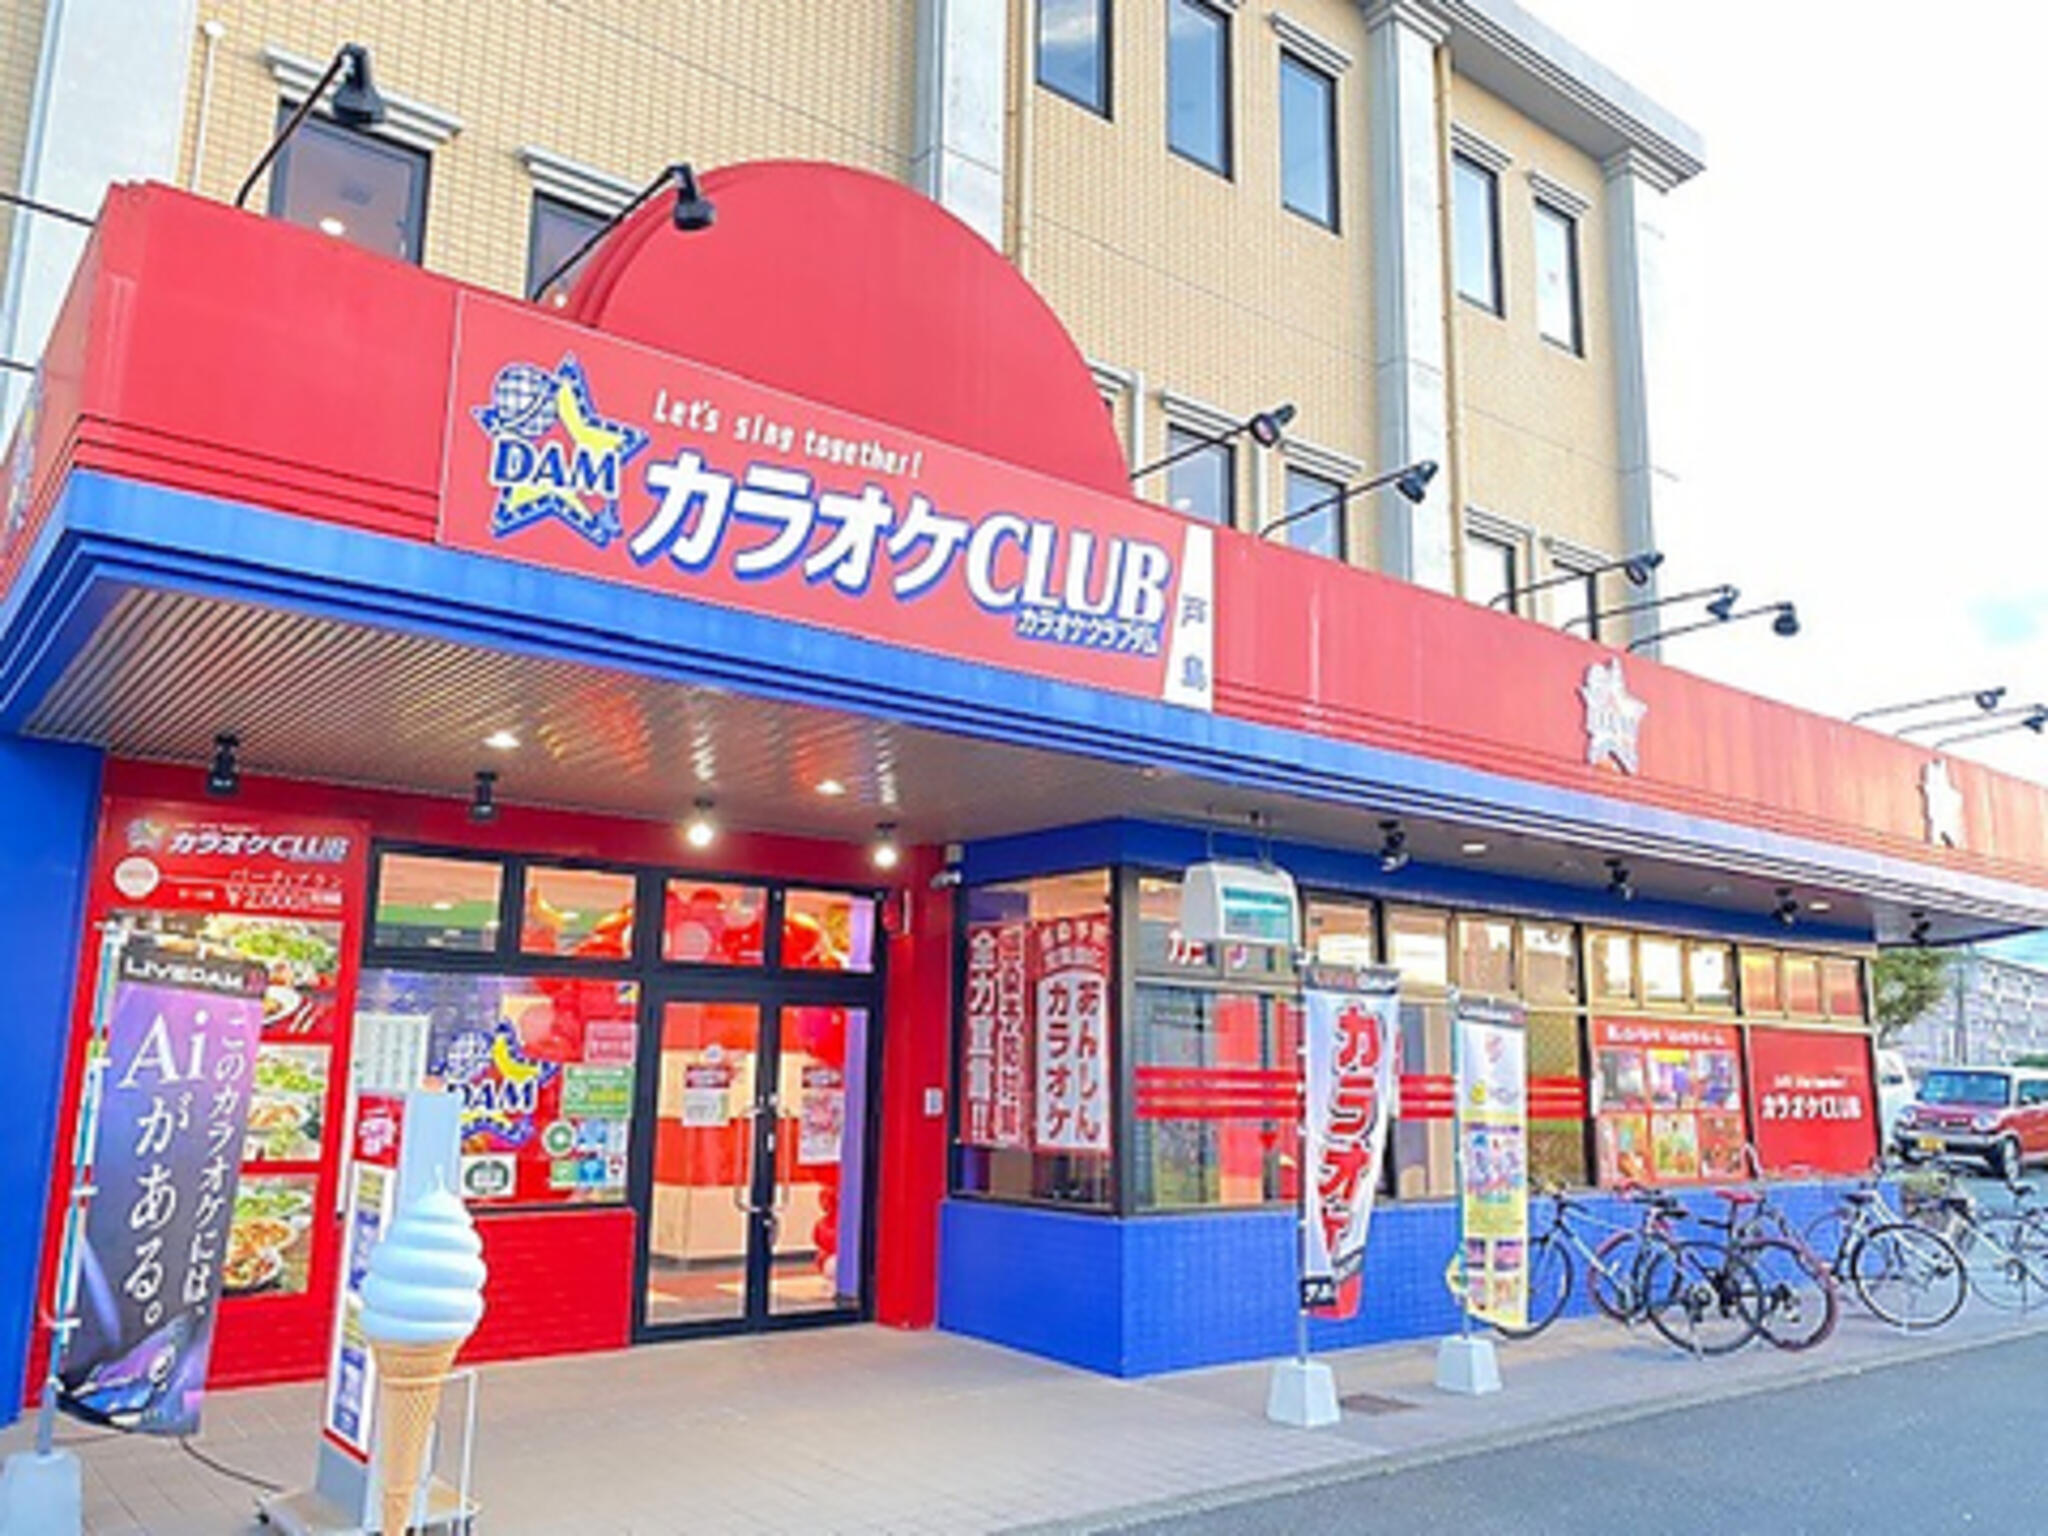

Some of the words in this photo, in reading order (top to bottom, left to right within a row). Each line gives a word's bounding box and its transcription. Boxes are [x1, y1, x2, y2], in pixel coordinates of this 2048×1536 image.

[490, 436, 620, 499] DAM
[652, 388, 721, 433] Let's
[733, 414, 795, 453] sing
[804, 428, 923, 479] together!
[629, 449, 1170, 624] カラオケCLUB
[1045, 981, 1071, 1140] カラオケ
[1074, 979, 1101, 1141] あんしん
